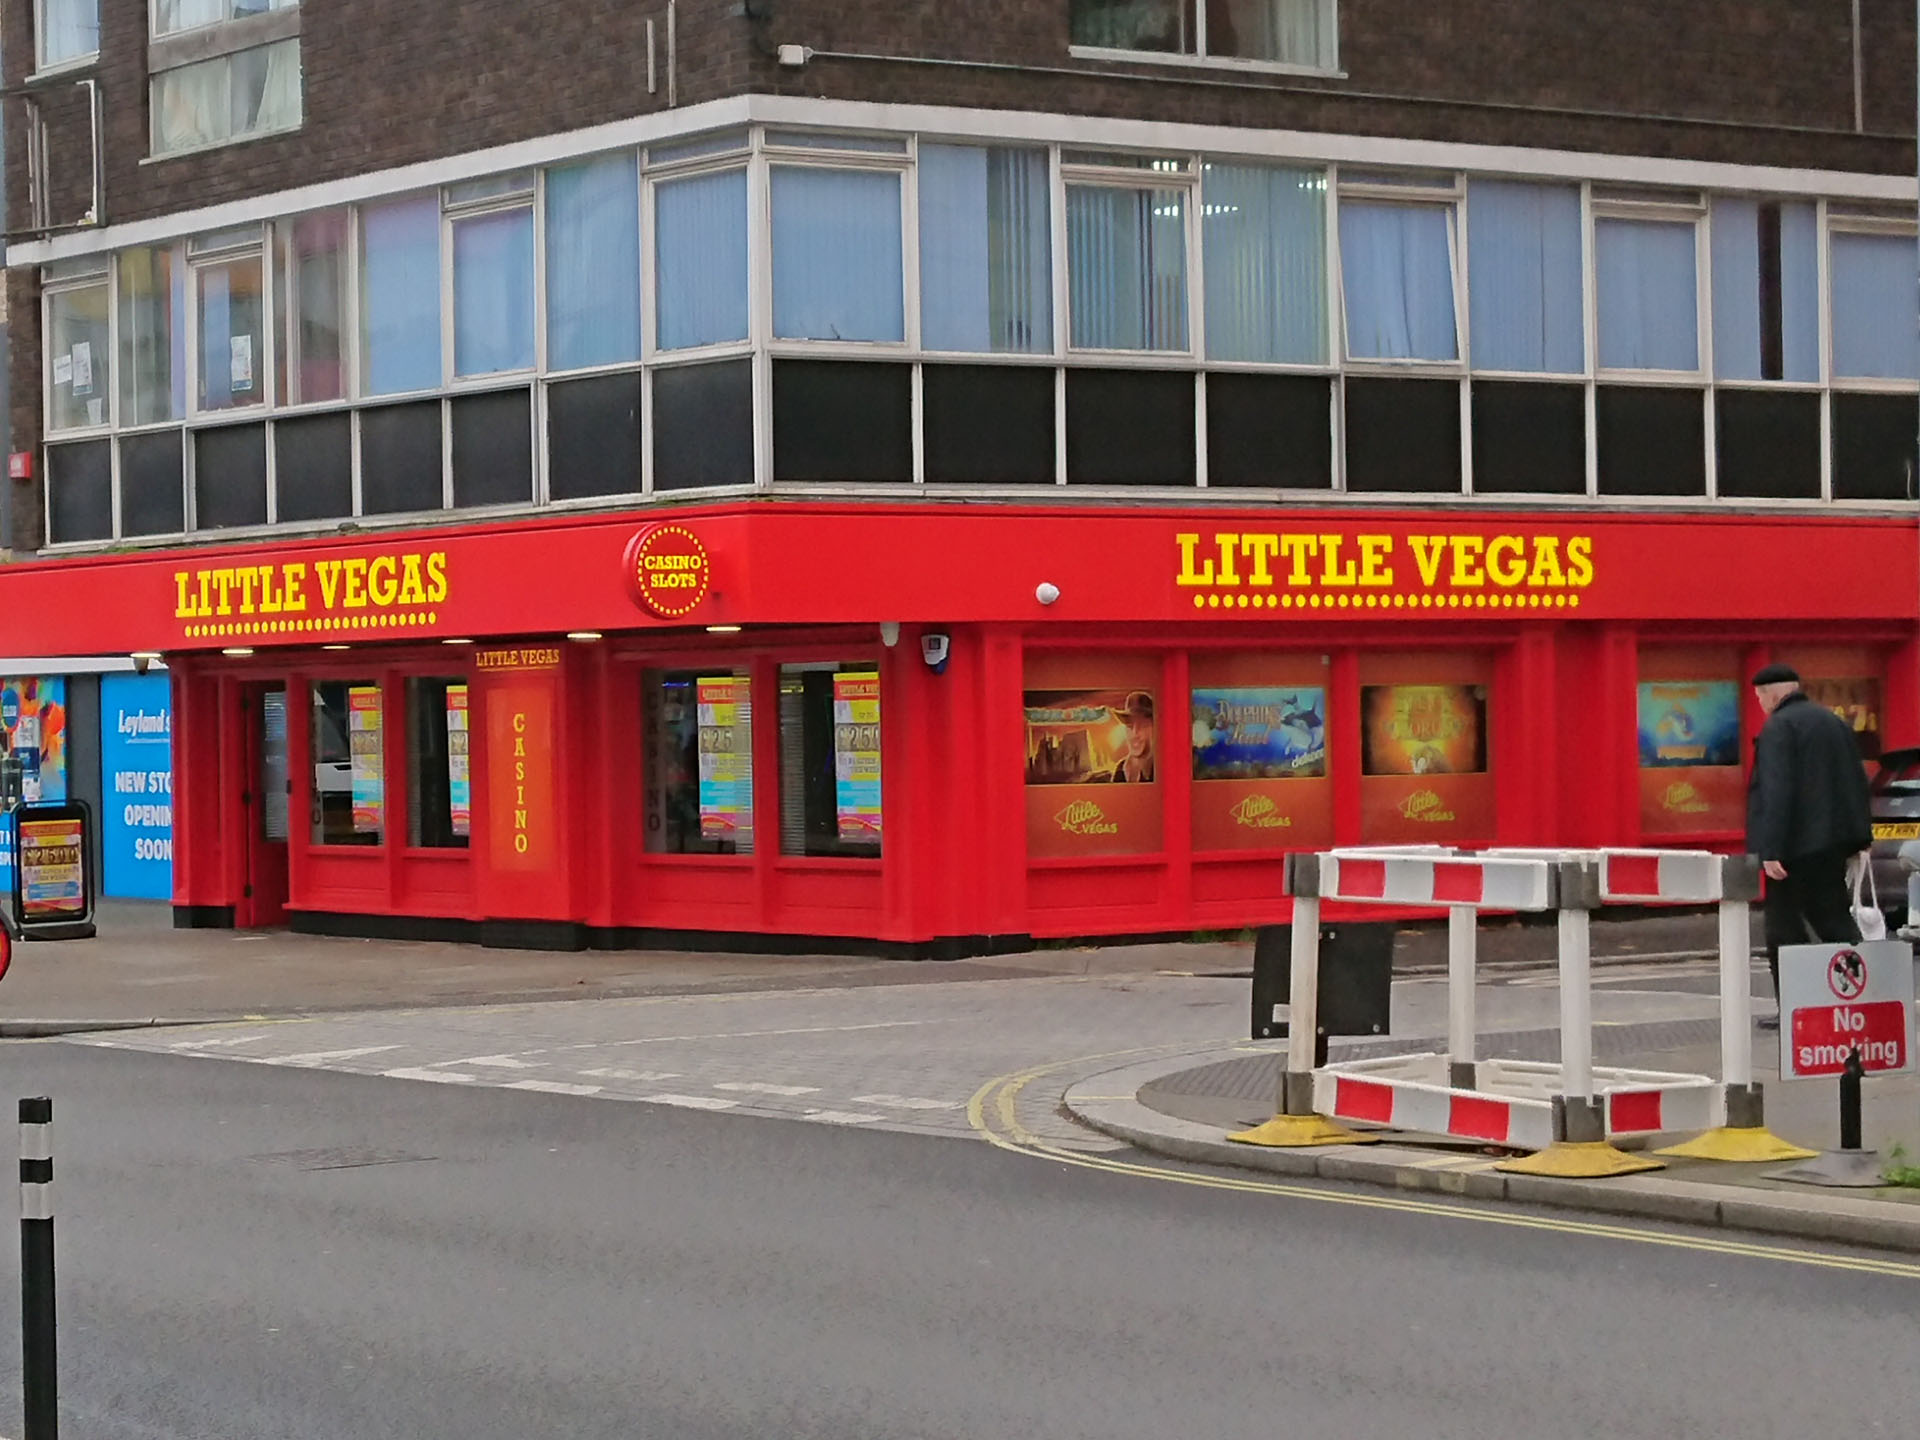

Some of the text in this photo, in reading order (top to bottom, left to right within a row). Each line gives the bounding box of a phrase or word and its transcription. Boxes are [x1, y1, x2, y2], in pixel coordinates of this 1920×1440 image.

[644, 555, 702, 570] CASINO
[1176, 533, 1594, 587] LITTLE VEGAS
[174, 552, 448, 618] LITTLE VEGAS
[651, 573, 697, 588] SLOTS
[476, 649, 560, 667] LITTLE VEGAS
[118, 708, 164, 737] Leyland
[115, 771, 146, 793] NEW
[513, 713, 529, 853] CASINO
[1082, 823, 1118, 834] VEGAS
[1257, 816, 1292, 828] VEGAS
[135, 838, 173, 860] SOON
[1833, 1006, 1865, 1032] No
